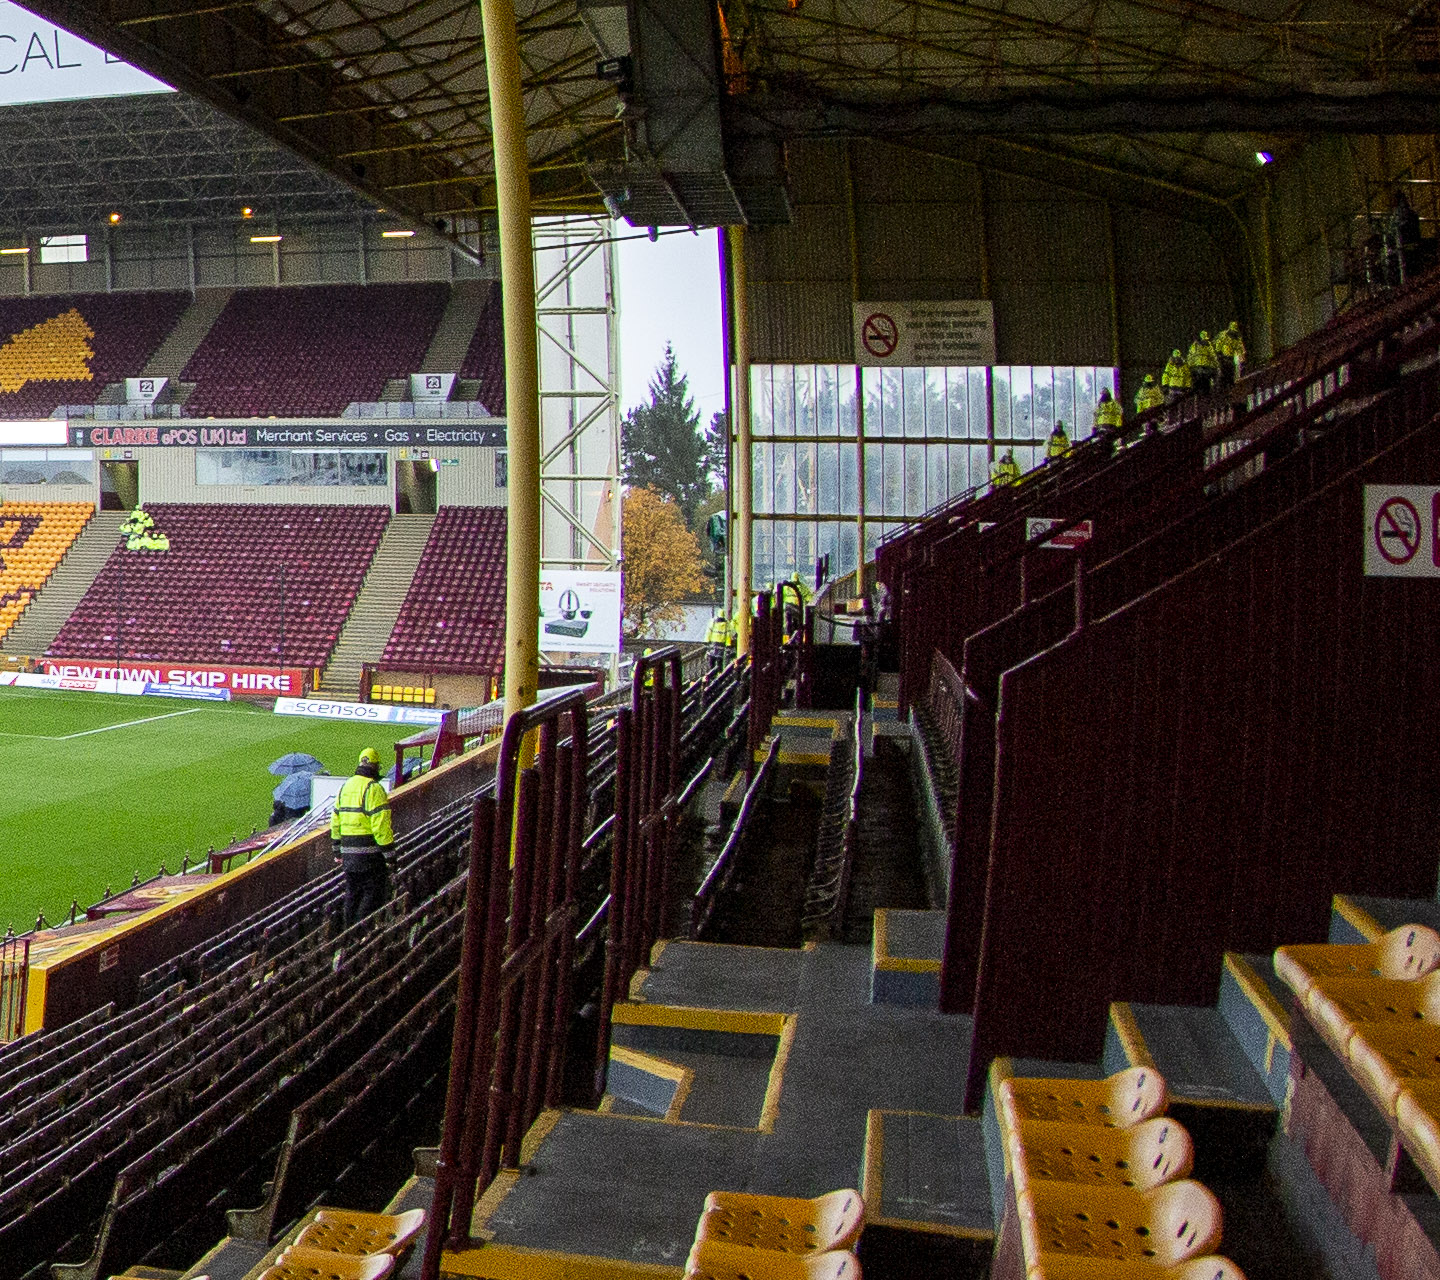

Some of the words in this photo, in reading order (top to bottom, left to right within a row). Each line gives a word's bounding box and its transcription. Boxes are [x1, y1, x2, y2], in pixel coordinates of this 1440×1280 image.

[90, 427, 159, 445] CLARKE
[256, 428, 303, 442] Merchant
[304, 428, 368, 442] Services
[384, 429, 410, 443] Gas
[425, 427, 487, 445] Electricity
[48, 665, 161, 684] NEWTOWN
[167, 670, 227, 688] SKIP
[231, 672, 291, 692] HIRE
[282, 701, 379, 718] ascensos
